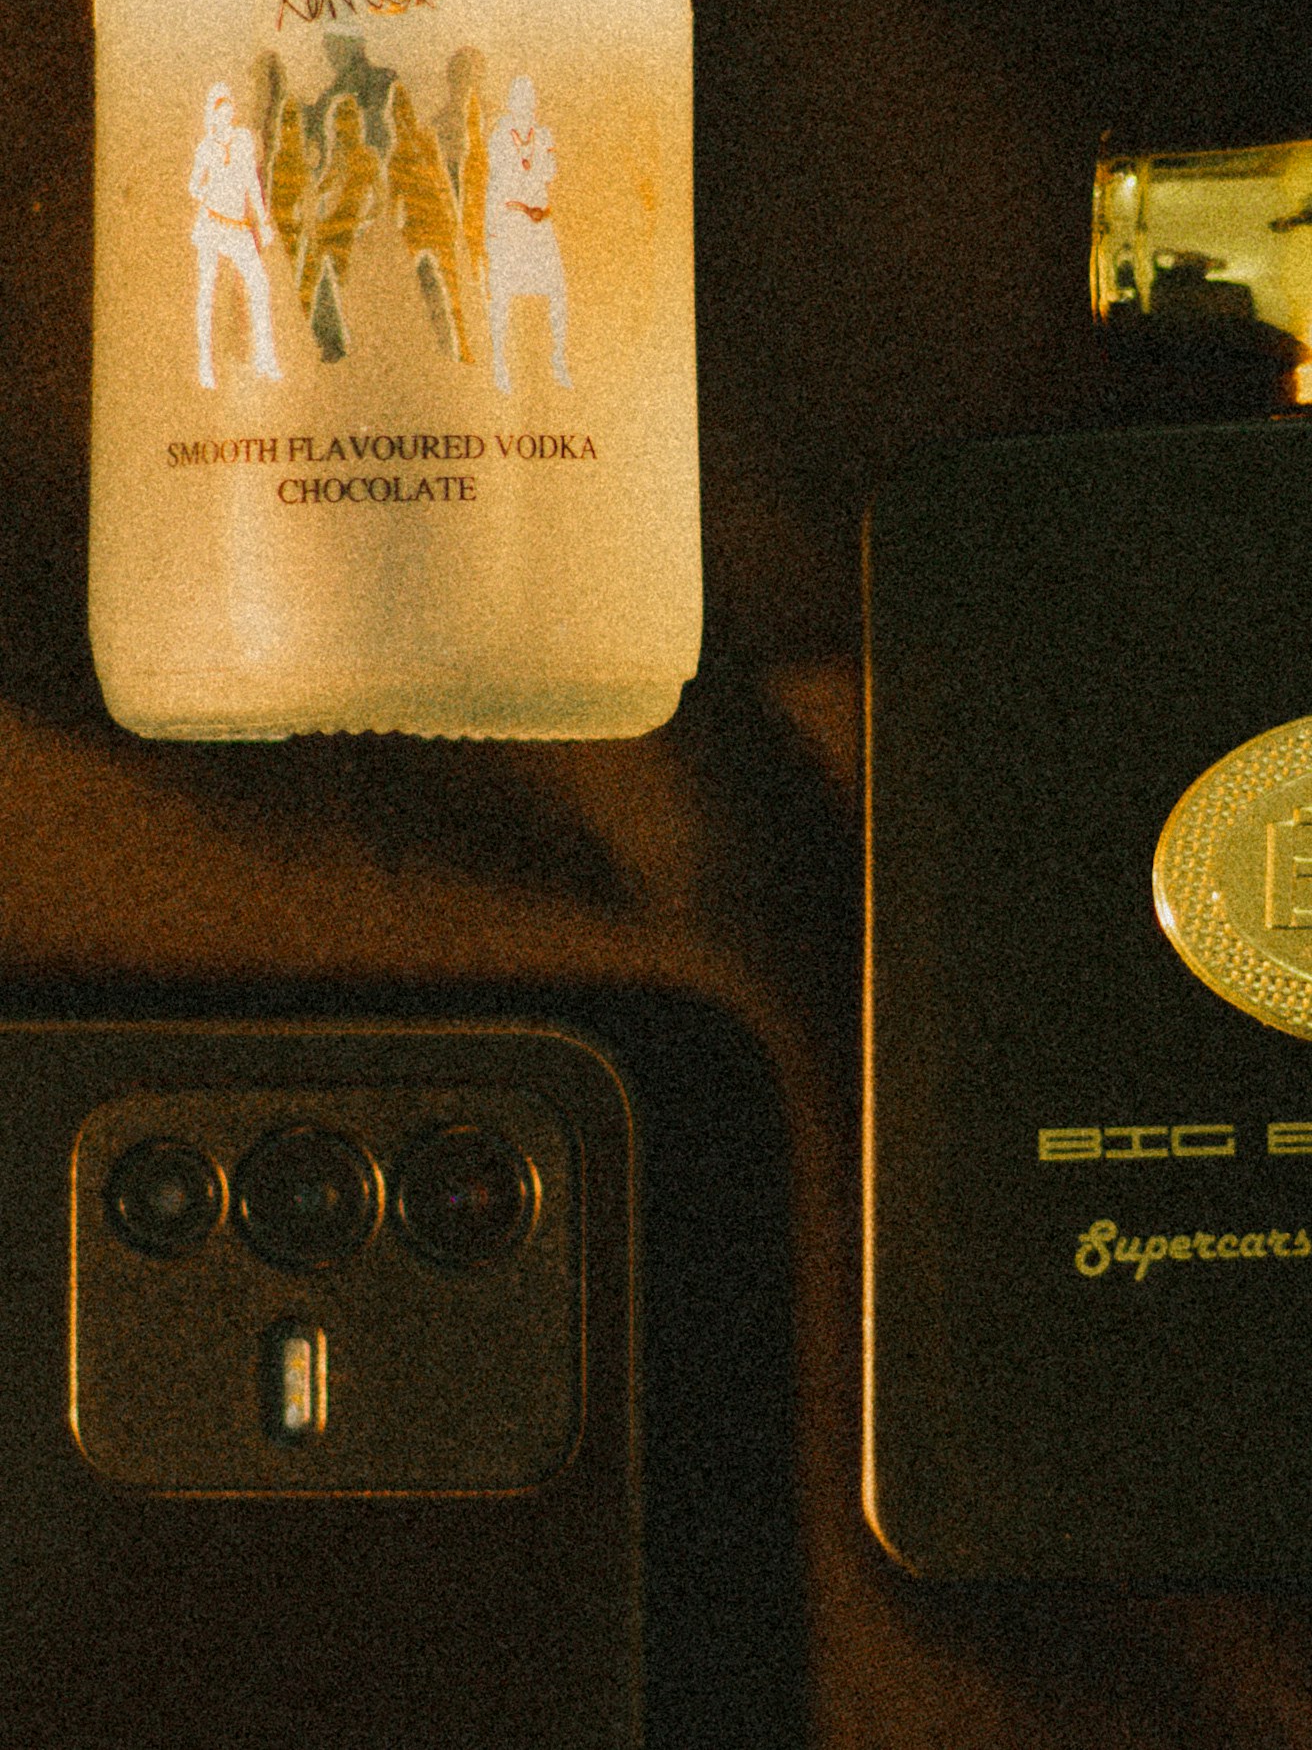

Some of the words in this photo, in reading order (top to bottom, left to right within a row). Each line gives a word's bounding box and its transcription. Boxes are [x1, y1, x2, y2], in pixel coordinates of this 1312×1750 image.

[167, 438, 279, 469] SMOOTH
[287, 435, 485, 463] FLAVOURED
[493, 434, 598, 460] VODKA
[277, 476, 476, 504] CHOCOLATE
[1038, 1124, 1235, 1160] BIG
[1075, 1219, 1312, 1281] Supercars
